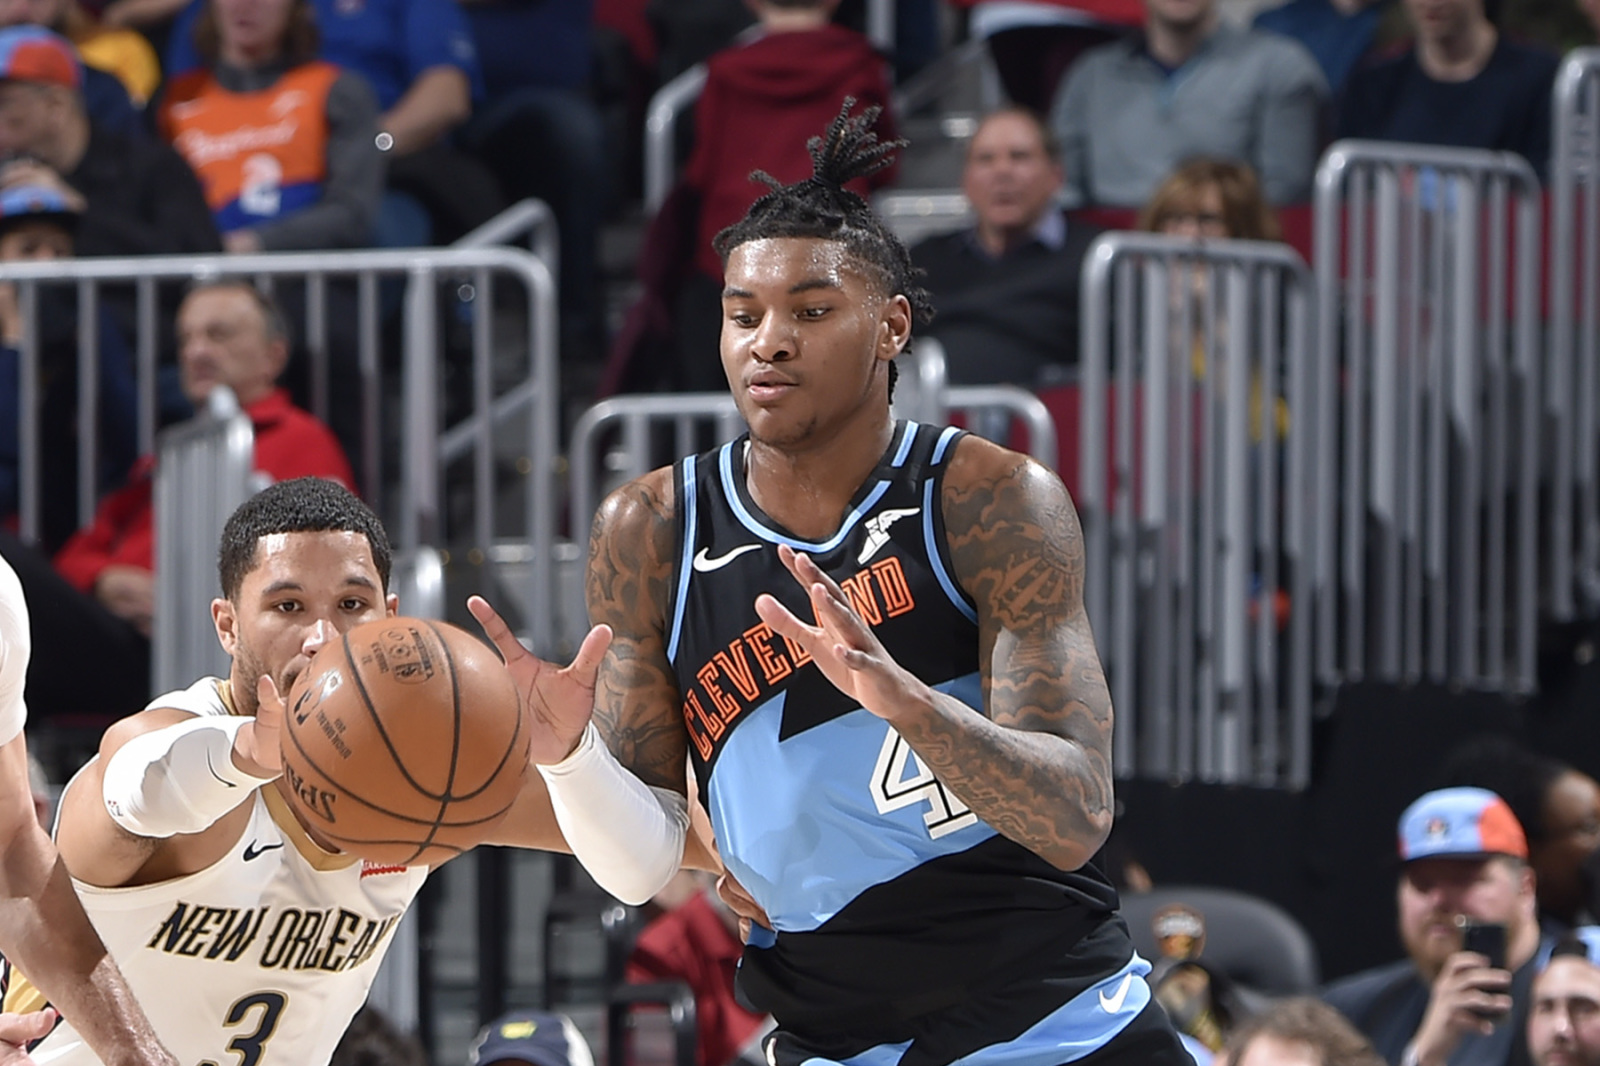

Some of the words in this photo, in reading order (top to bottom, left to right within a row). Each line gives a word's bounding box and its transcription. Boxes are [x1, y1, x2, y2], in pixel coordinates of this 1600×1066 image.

[239, 152, 283, 217] 2
[869, 725, 979, 840] 4
[146, 901, 268, 962] NEW
[259, 907, 402, 973] ORLEAN
